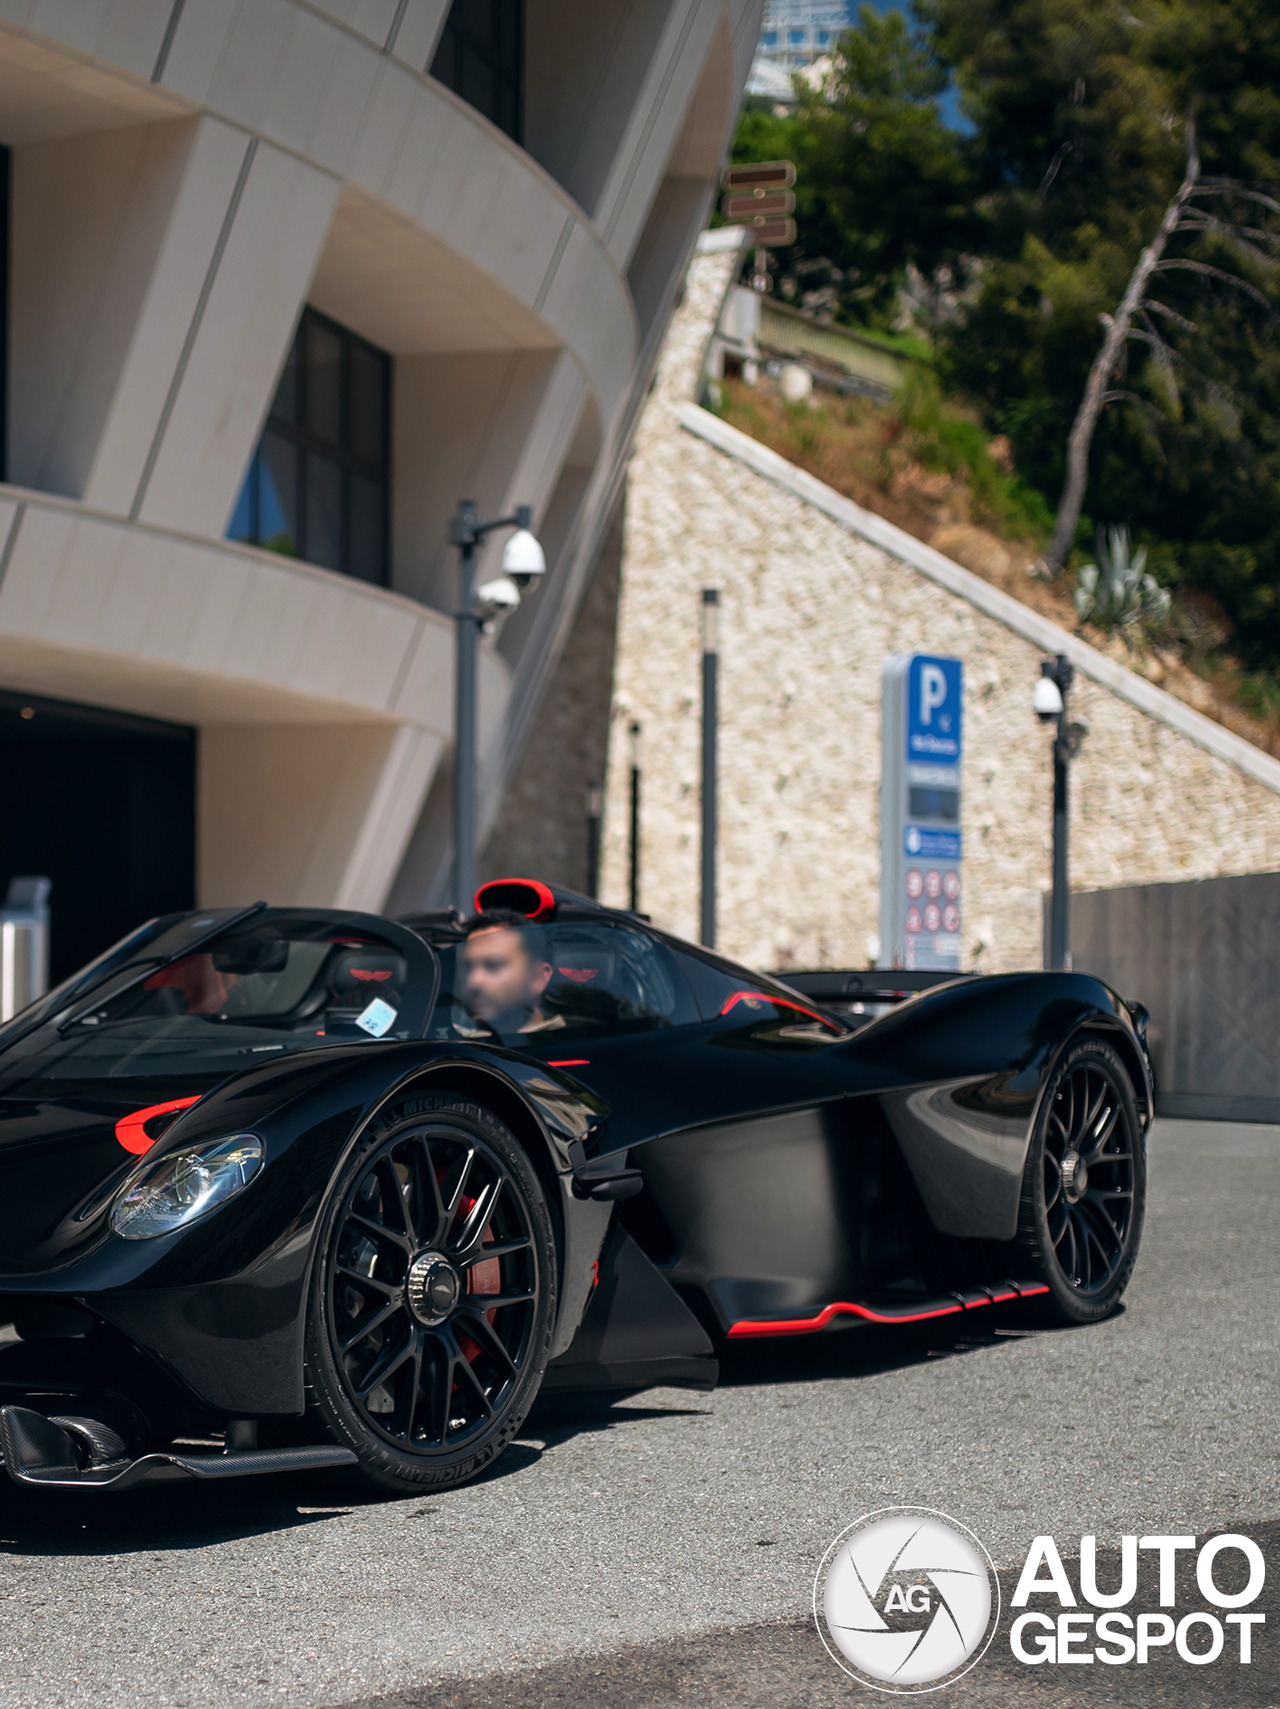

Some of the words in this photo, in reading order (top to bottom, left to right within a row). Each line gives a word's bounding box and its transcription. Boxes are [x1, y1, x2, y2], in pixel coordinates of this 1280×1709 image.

[920, 662, 947, 726] P
[403, 1097, 482, 1122] MICHELIN
[395, 1457, 475, 1483] MICHELIN
